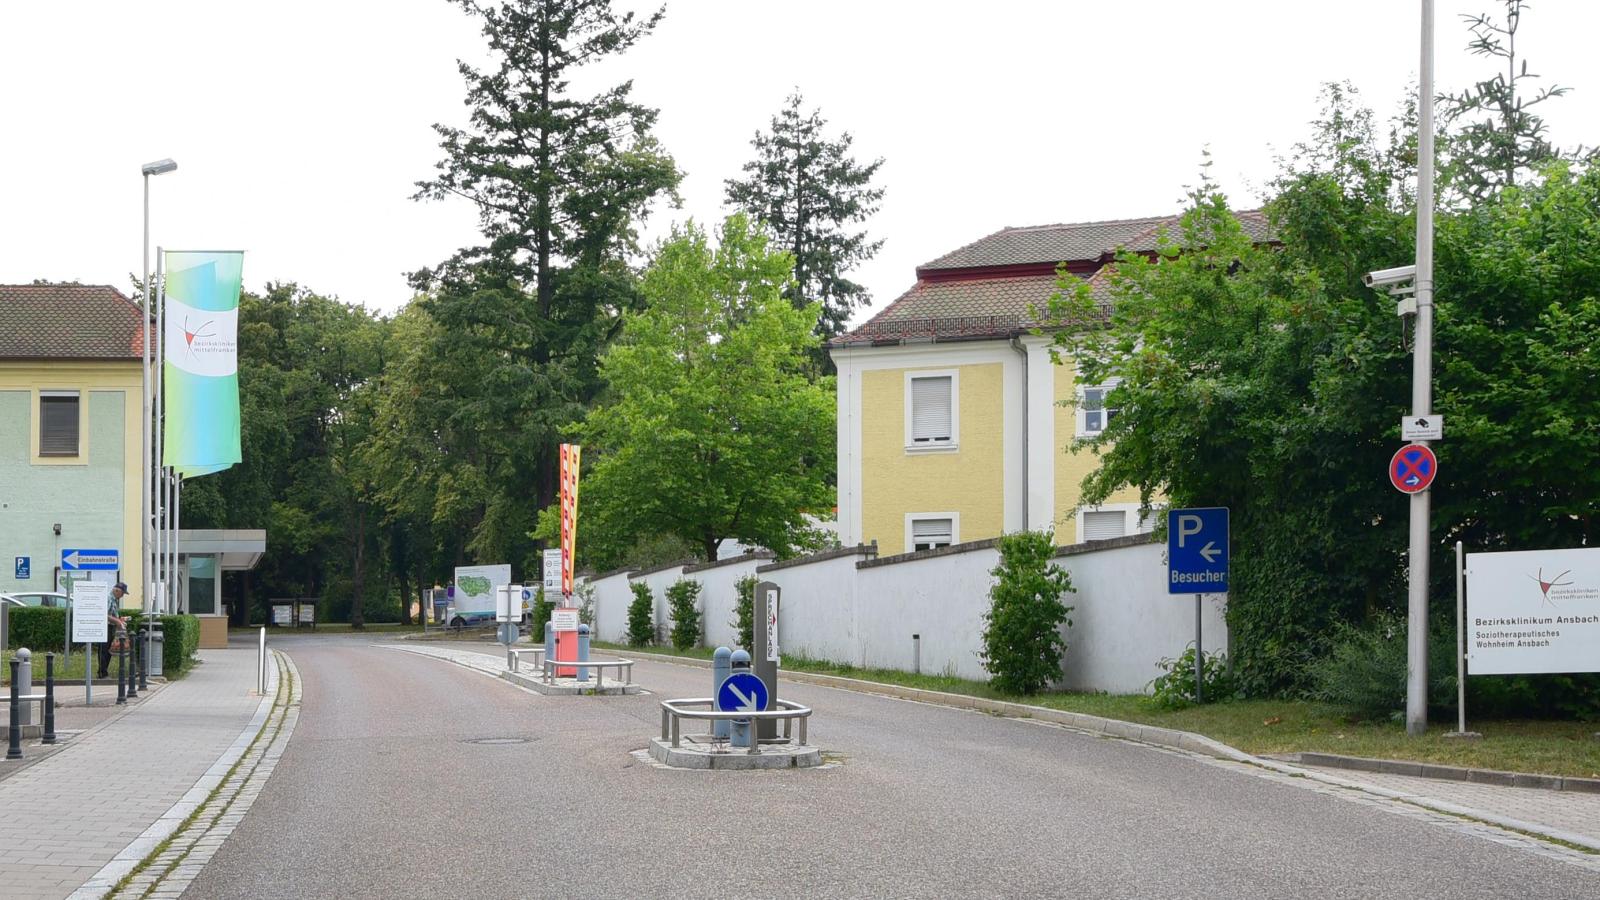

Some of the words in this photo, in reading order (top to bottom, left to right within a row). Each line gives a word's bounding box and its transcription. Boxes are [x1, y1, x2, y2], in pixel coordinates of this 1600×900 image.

[1178, 515, 1203, 548] P
[1171, 569, 1225, 583] Besucher
[1475, 617, 1553, 626] Bezirksklinikum
[1556, 615, 1599, 624] Ansbach
[1476, 630, 1560, 639] Soziotherapeutisches
[1476, 640, 1515, 648] Wohnheim
[1517, 639, 1550, 647] Ansbach
